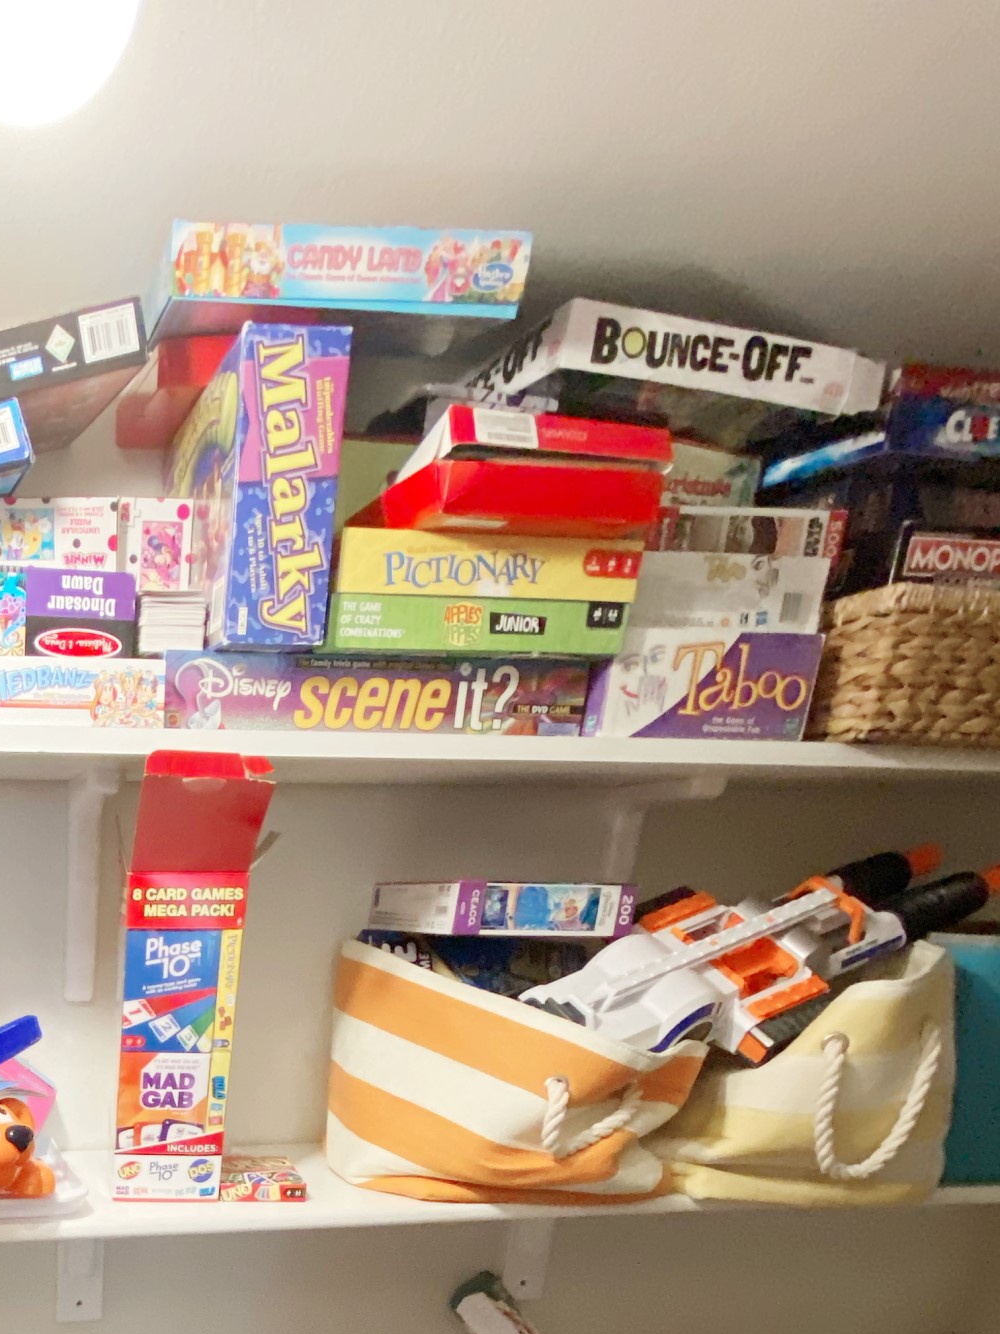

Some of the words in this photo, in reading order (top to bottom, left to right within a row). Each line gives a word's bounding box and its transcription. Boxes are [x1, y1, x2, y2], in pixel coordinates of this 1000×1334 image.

[286, 243, 363, 271] CANDY
[366, 245, 424, 274] LAND
[590, 316, 813, 384] BOUNCE-OFF
[258, 334, 325, 634] Malarky
[62, 553, 106, 567] MINNIE
[910, 544, 1000, 574] MONOP
[383, 550, 546, 589] PICTIONARY
[61, 575, 104, 595] Dawn
[47, 595, 116, 617] Dinosaur
[343, 602, 357, 612] THE
[359, 602, 382, 612] GAME
[340, 614, 352, 625] OF
[354, 614, 382, 625] CRAZY
[495, 614, 540, 634] JUNIOR
[310, 658, 331, 669] family
[333, 659, 351, 668] trivia
[352, 660, 371, 669] game
[672, 640, 807, 716] Taboo
[293, 675, 452, 732] scene
[453, 661, 520, 731] it?
[531, 705, 549, 714] DVD
[132, 888, 143, 901] 8
[145, 887, 188, 901] CARD
[190, 887, 244, 901] GAMES
[143, 904, 188, 918] MEGA
[190, 903, 235, 917] PACK!
[468, 889, 480, 927] CEACO
[618, 894, 634, 926] 200
[145, 936, 203, 961] Phase
[161, 954, 191, 979] 10
[142, 1072, 196, 1090] MAD
[141, 1091, 195, 1109] GAB
[167, 1144, 219, 1153] INCLUDES:
[117, 1162, 142, 1178] UNO
[149, 1161, 179, 1172] Phase
[158, 1171, 172, 1181] 10
[188, 1162, 214, 1178] DOS
